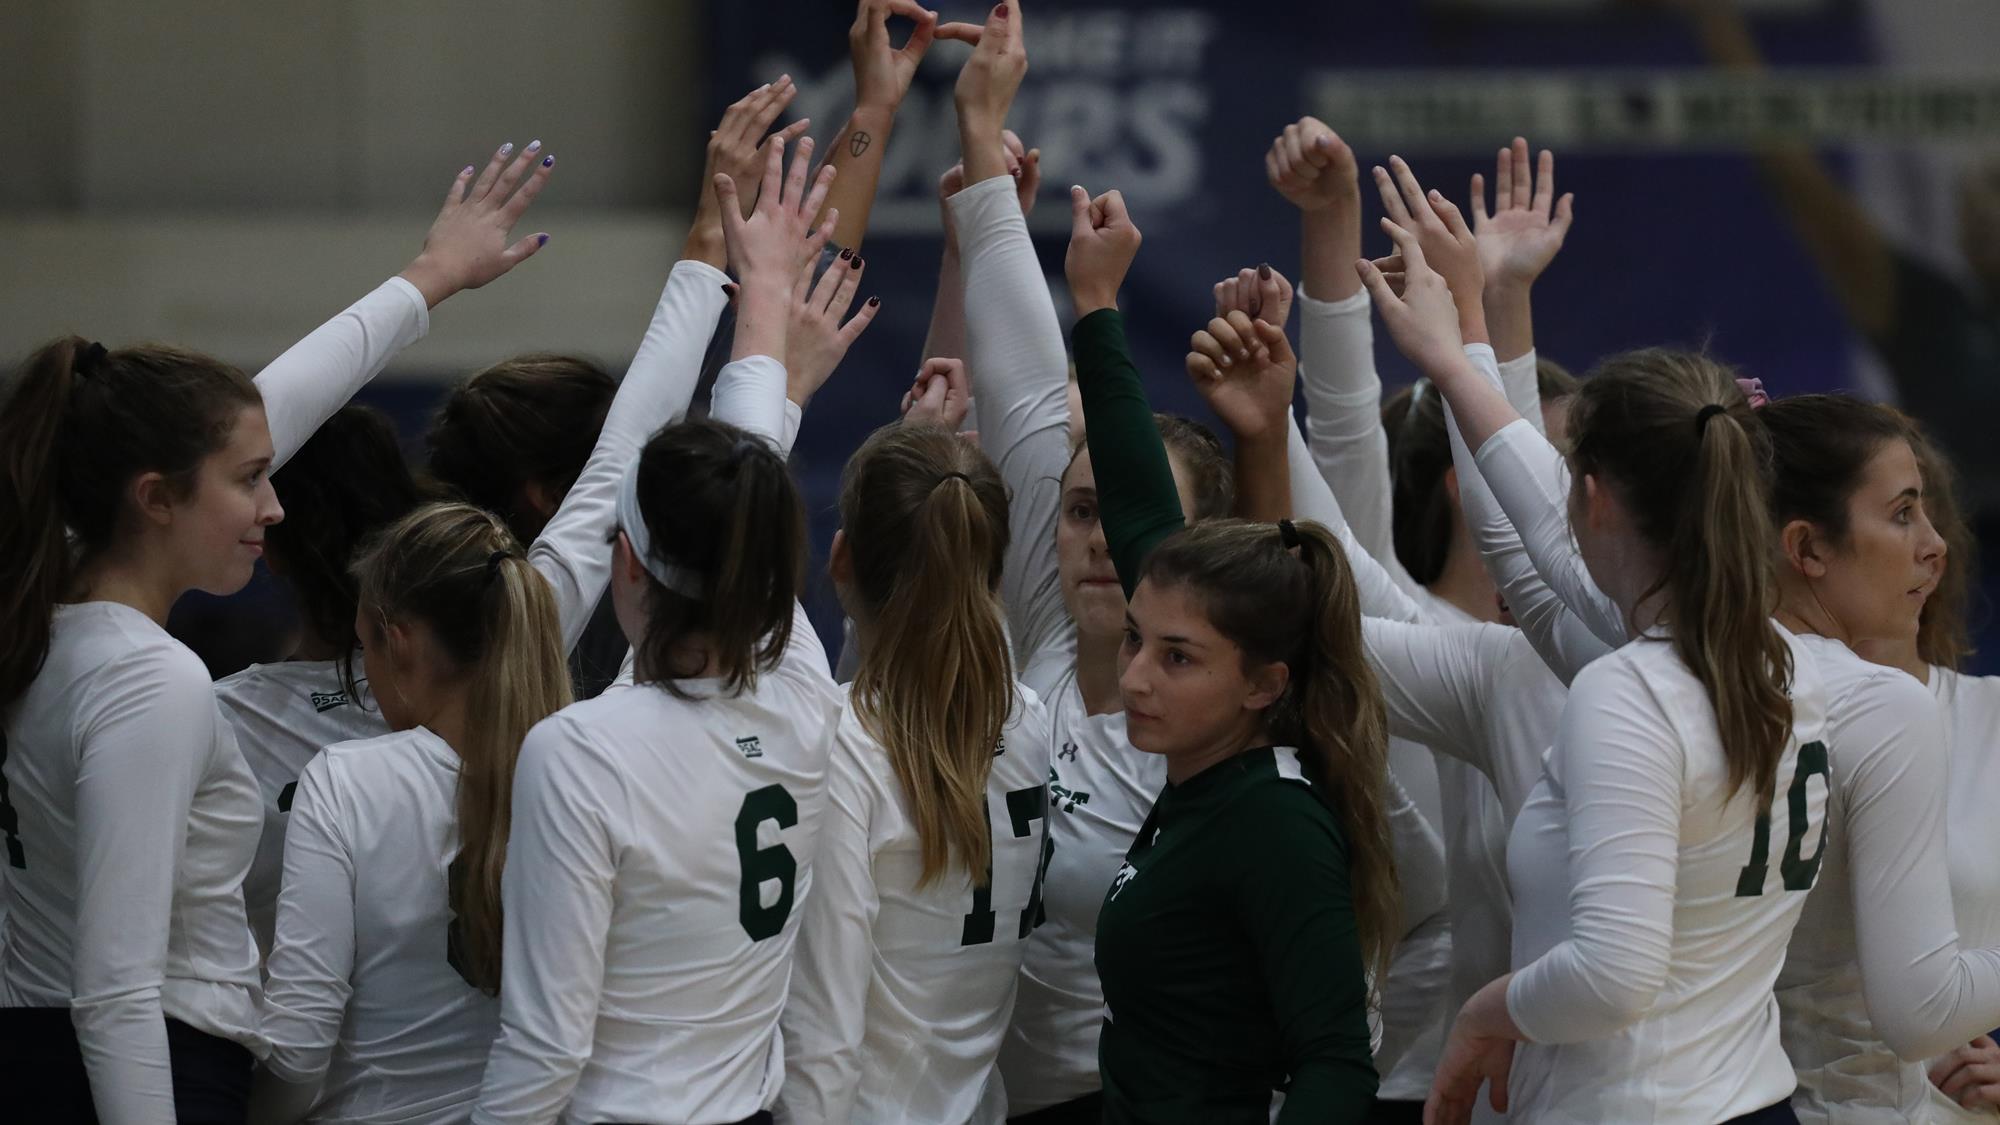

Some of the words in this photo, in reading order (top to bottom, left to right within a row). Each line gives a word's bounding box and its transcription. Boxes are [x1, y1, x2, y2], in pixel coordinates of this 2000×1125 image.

[755, 50, 1215, 202] YRS
[735, 783, 798, 942] 6
[961, 782, 1048, 946] 17
[1735, 740, 1830, 898] 10
